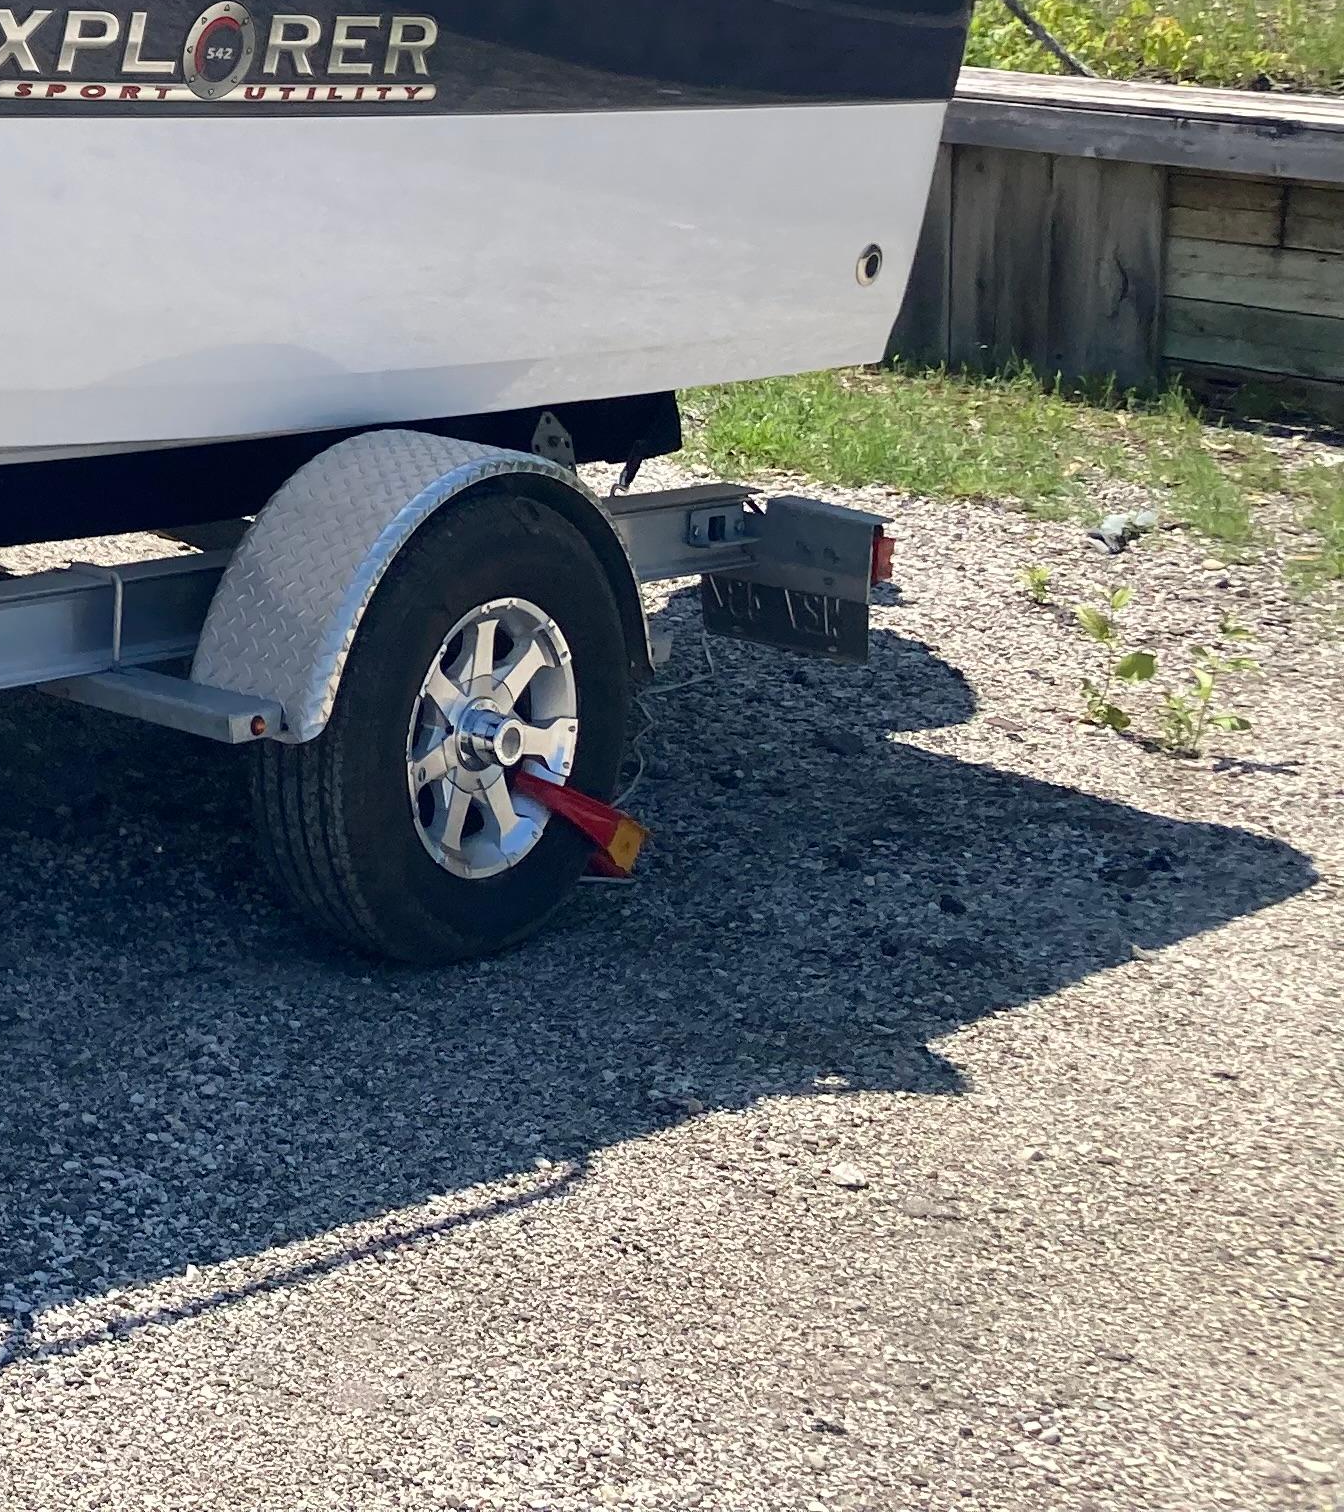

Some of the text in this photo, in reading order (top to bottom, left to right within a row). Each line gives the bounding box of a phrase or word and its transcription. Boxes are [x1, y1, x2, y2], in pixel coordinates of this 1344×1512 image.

[206, 47, 233, 60] 542
[13, 83, 424, 101] SPORT UTILITY
